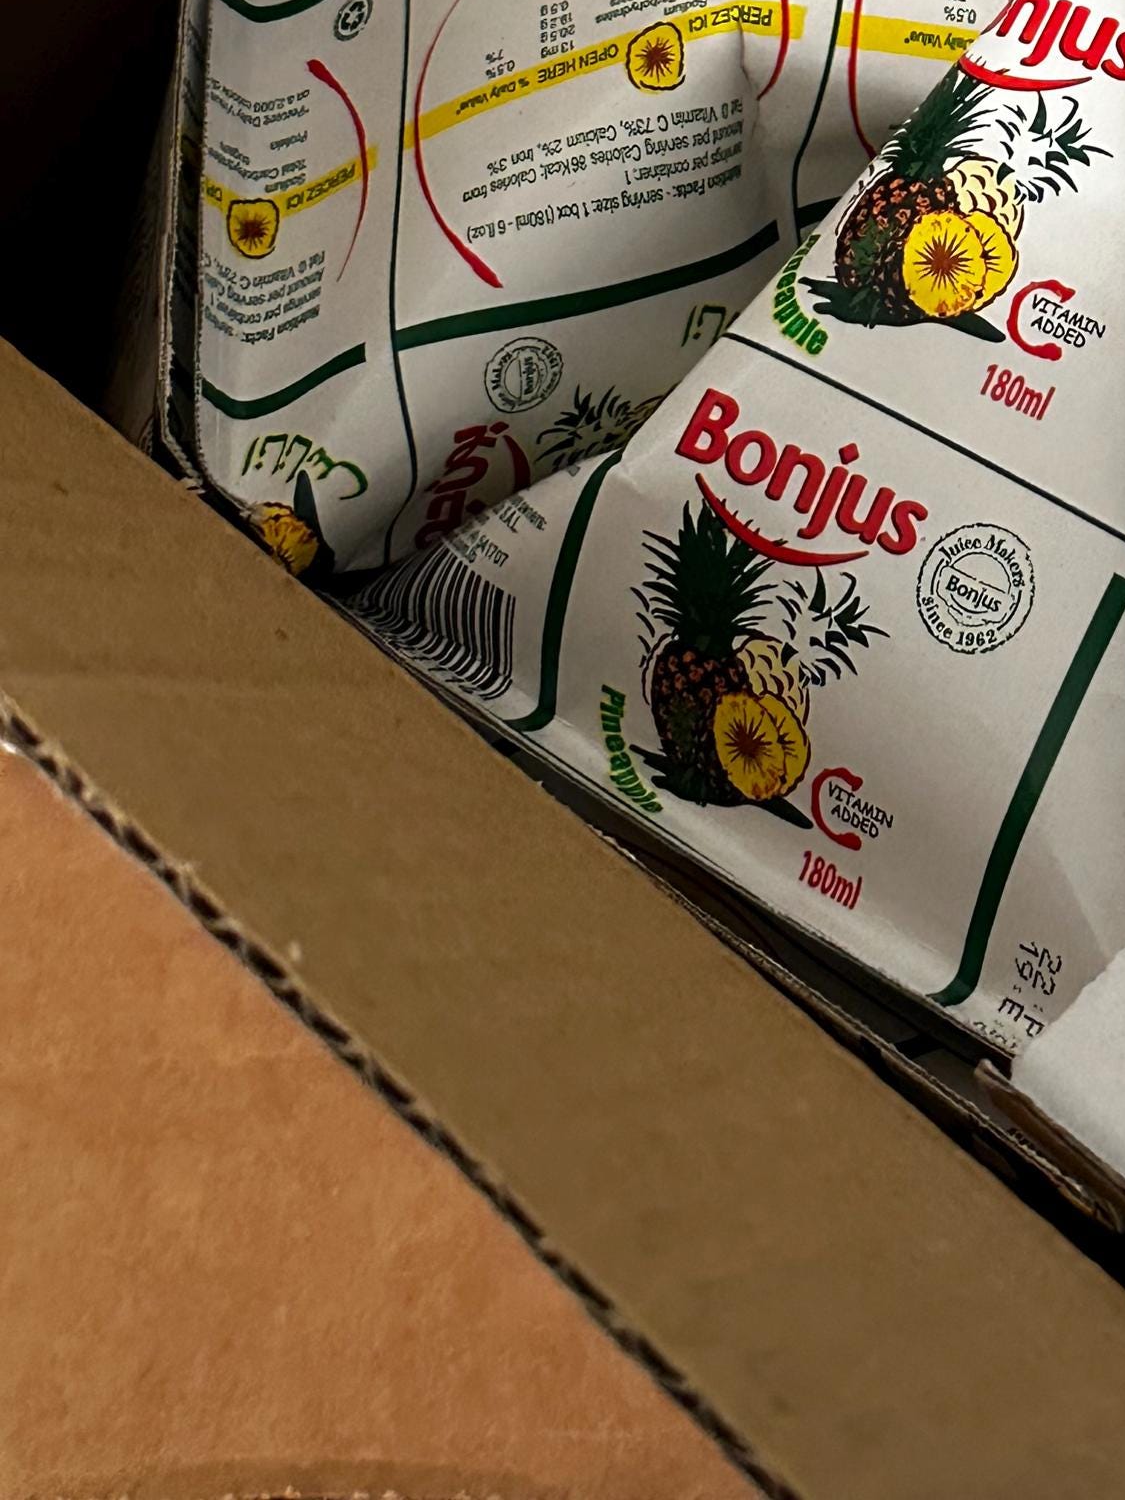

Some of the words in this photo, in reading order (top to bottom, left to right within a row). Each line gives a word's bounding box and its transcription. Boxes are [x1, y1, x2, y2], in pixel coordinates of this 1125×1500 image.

[712, 5, 774, 26] PERCEZ
[943, 5, 977, 24] 0.5%
[579, 43, 619, 65] OPEN
[537, 58, 576, 84] HERE
[657, 114, 669, 131] C
[671, 106, 718, 129] Vitamin
[566, 124, 617, 148] Calcium
[644, 135, 689, 156] serving
[692, 128, 710, 147] per
[590, 144, 641, 166] Calories
[490, 168, 537, 192] Calories
[621, 188, 663, 208] serving
[1031, 294, 1106, 338] VITAMIN
[1030, 316, 1086, 348] ADDED
[980, 364, 1056, 420] 180ml
[674, 387, 929, 556] Bonjus
[938, 537, 982, 564] Juice
[945, 574, 1002, 612] Bonjus
[955, 629, 998, 647] 1962
[599, 683, 664, 813] Pineapple
[828, 781, 894, 829] VITAMIN
[830, 804, 879, 838] ADDED
[798, 850, 863, 910] 180ml
